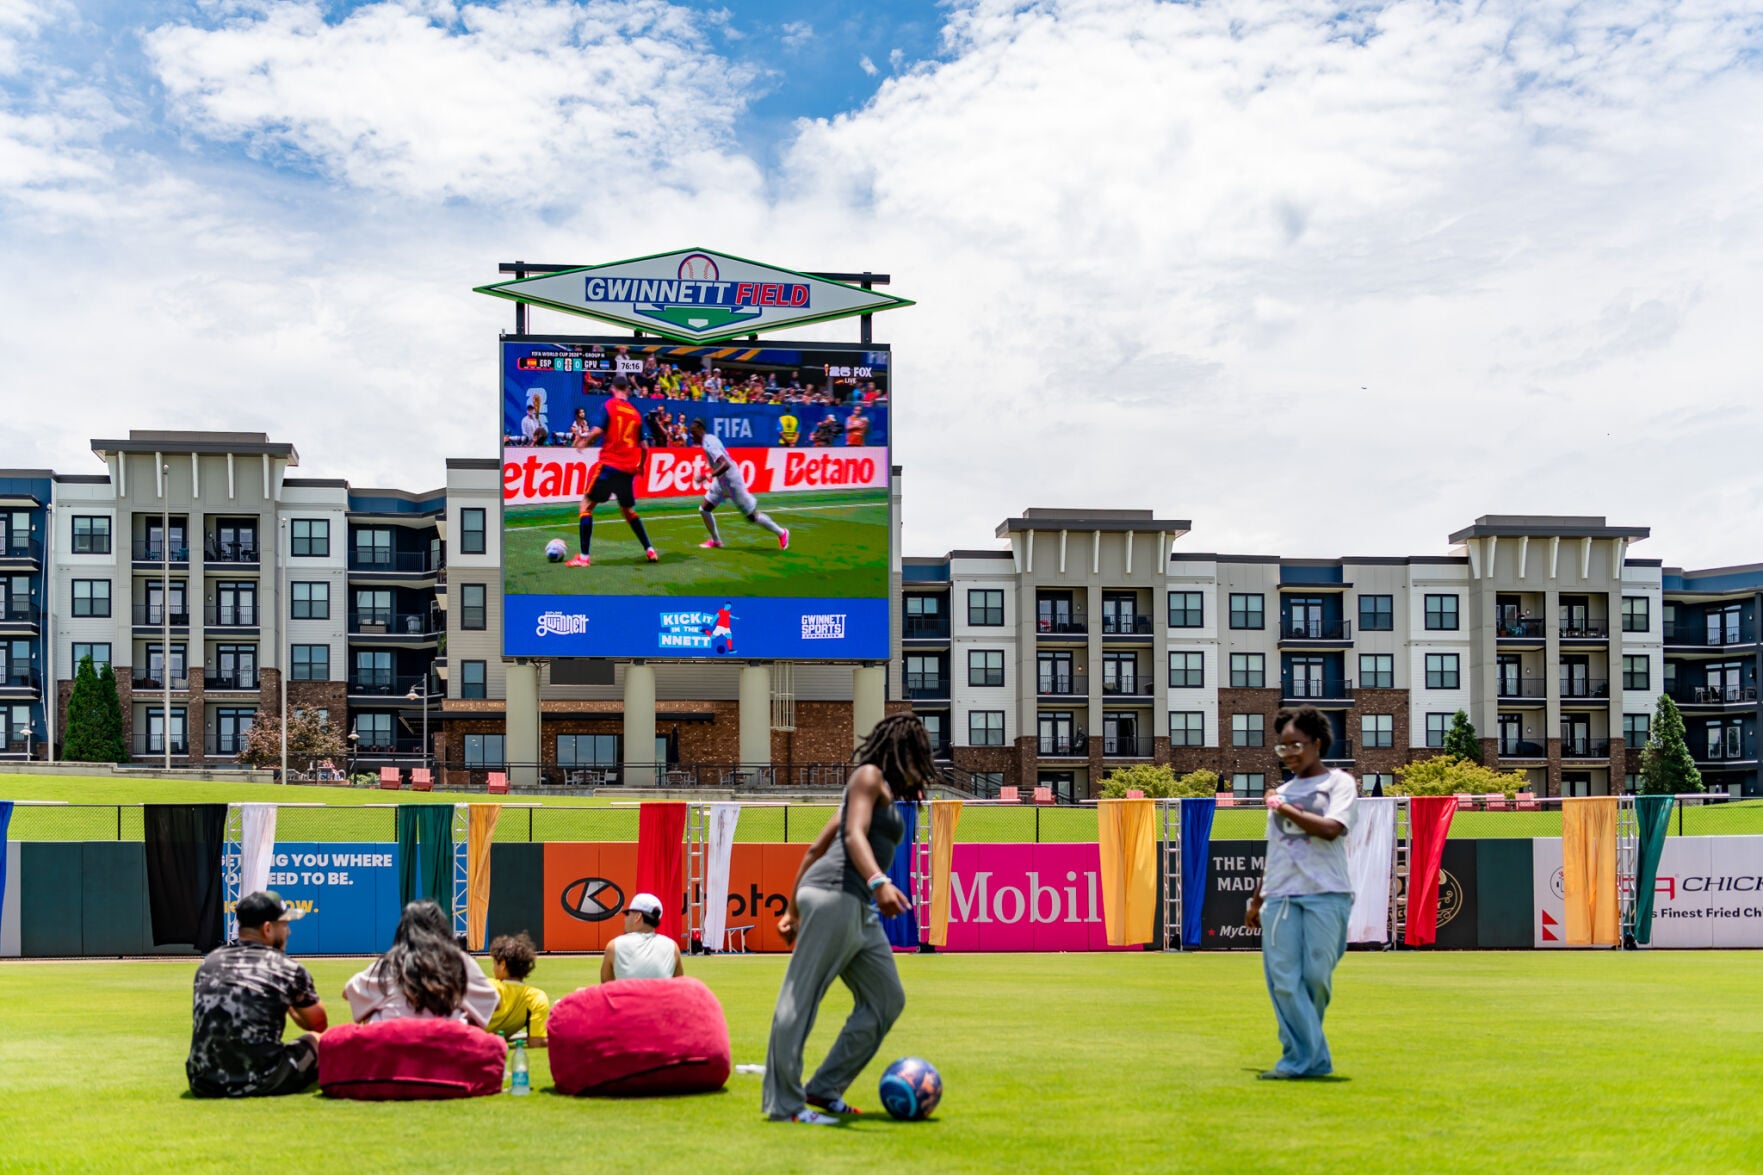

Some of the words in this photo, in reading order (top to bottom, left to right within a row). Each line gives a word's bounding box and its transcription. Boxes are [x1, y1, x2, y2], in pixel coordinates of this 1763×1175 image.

[587, 278, 731, 304] GWINNETT
[735, 283, 809, 307] FIELD
[621, 362, 640, 370] 76:16
[854, 367, 872, 377] FOX
[713, 417, 753, 438] FIFA
[784, 452, 875, 487] Betano
[504, 455, 599, 499] etan
[663, 613, 701, 626] KICK
[702, 615, 713, 624] IT
[802, 614, 847, 625] GWINNETT
[802, 624, 841, 634] SPORTS
[661, 635, 711, 647] NNETT
[291, 853, 329, 867] YOU
[332, 854, 393, 868] WHERE
[1213, 856, 1246, 871] THE
[268, 871, 299, 885] EED
[301, 872, 325, 886] TO
[328, 872, 354, 886] BE.
[948, 871, 1102, 925] Mobil
[1661, 908, 1703, 919] Finest
[1706, 907, 1741, 919] Fried
[1743, 907, 1763, 919] Ch
[1219, 925, 1264, 939] MyCou
